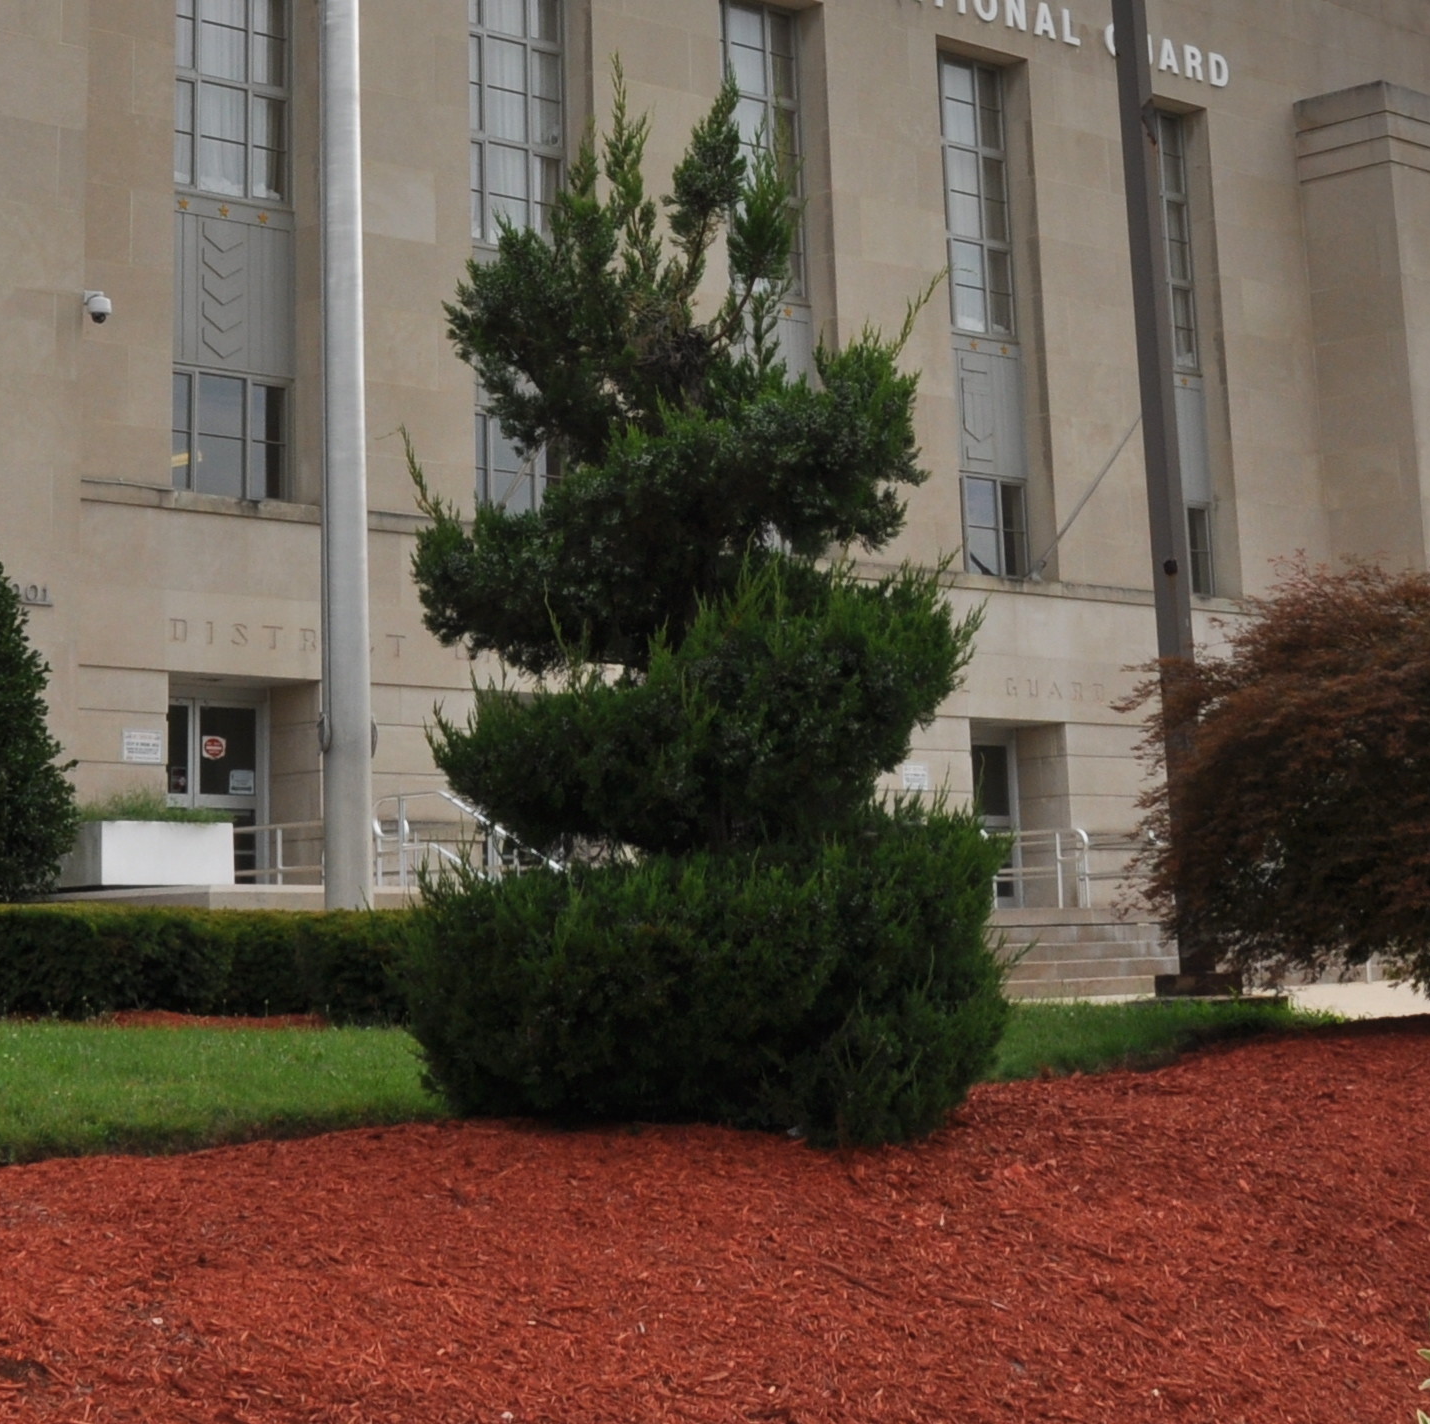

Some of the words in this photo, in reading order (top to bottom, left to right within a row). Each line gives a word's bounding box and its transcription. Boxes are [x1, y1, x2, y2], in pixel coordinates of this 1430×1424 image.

[1104, 22, 1230, 88] ARD
[169, 618, 407, 659] DISTRT
[1004, 677, 1106, 704] GUARD
